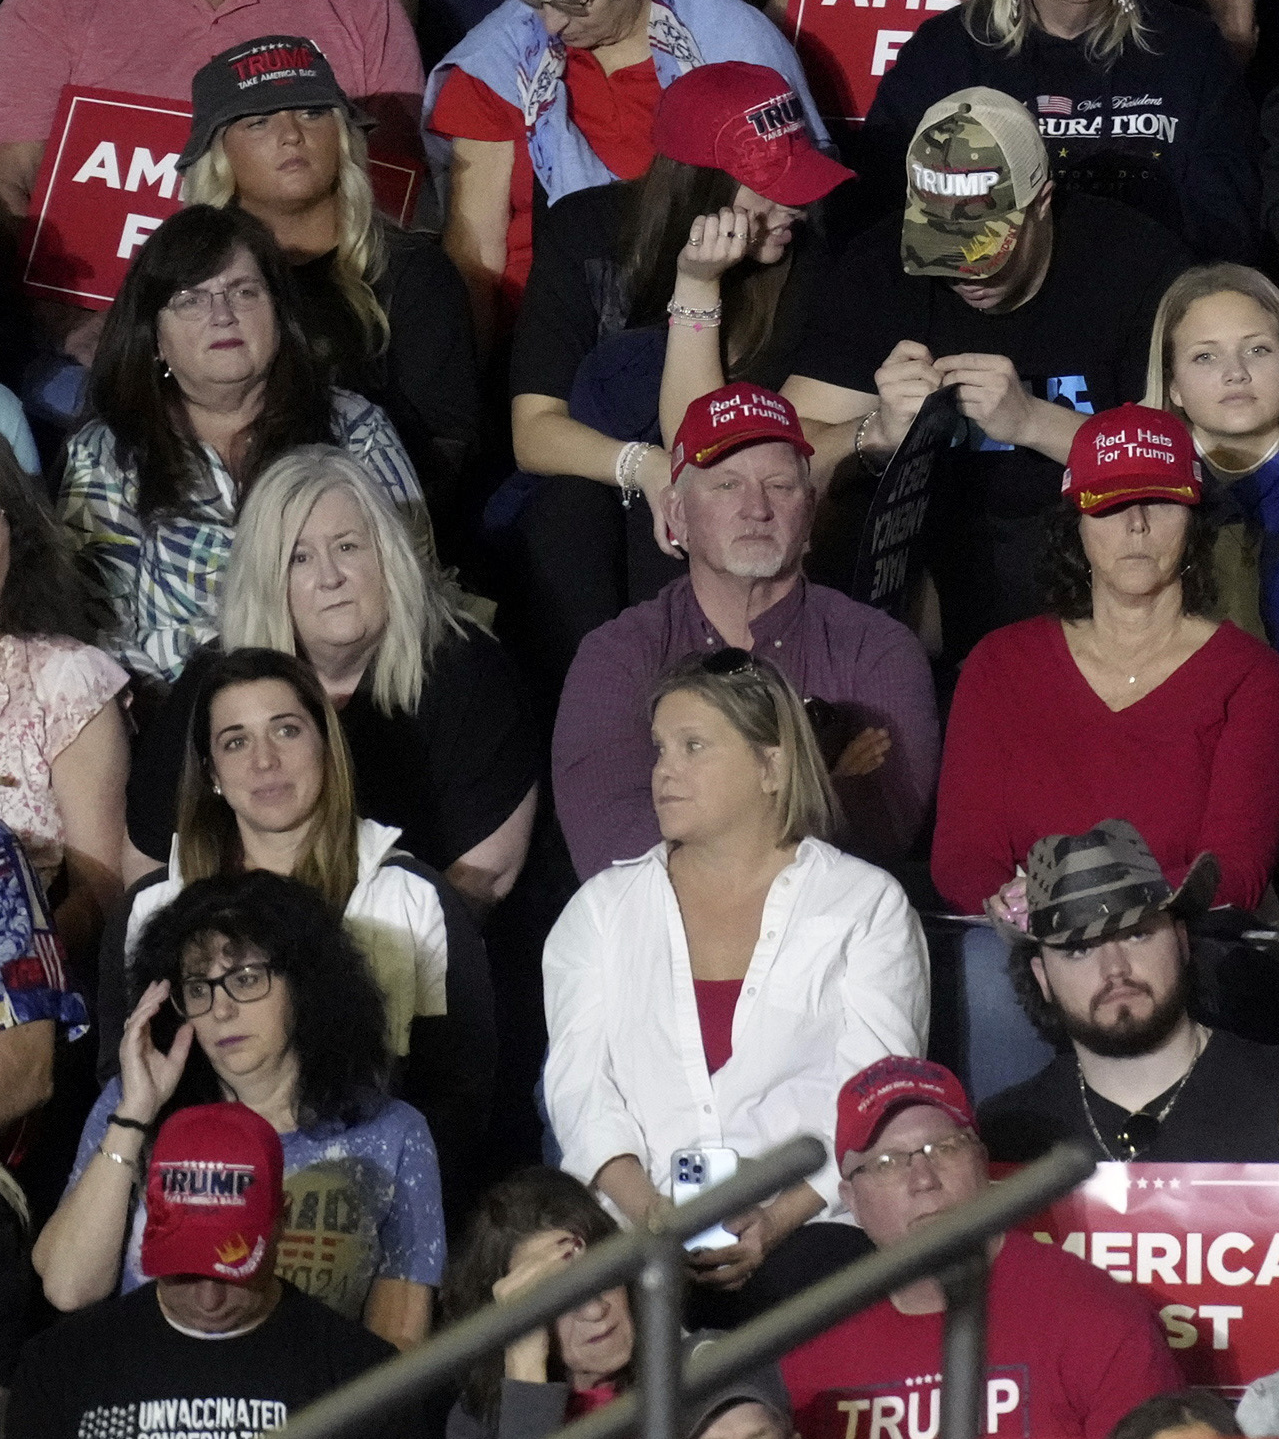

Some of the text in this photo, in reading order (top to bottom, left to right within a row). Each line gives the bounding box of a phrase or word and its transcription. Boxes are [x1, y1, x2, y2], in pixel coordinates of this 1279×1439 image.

[233, 46, 314, 80] TRUMP
[238, 74, 259, 90] TAKE
[260, 69, 297, 83] AMERICA
[1111, 94, 1164, 110] President
[762, 129, 782, 142] TAKE
[911, 163, 1001, 196] TRUMP
[708, 393, 786, 415] Red Hats
[711, 404, 791, 427] For Trump
[1093, 428, 1173, 450] Red Hats
[1097, 442, 1175, 466] For Trump
[160, 1168, 256, 1196] TRUMP
[137, 1396, 287, 1431] UNVACCINATED
[837, 1377, 1021, 1439] TRUP
